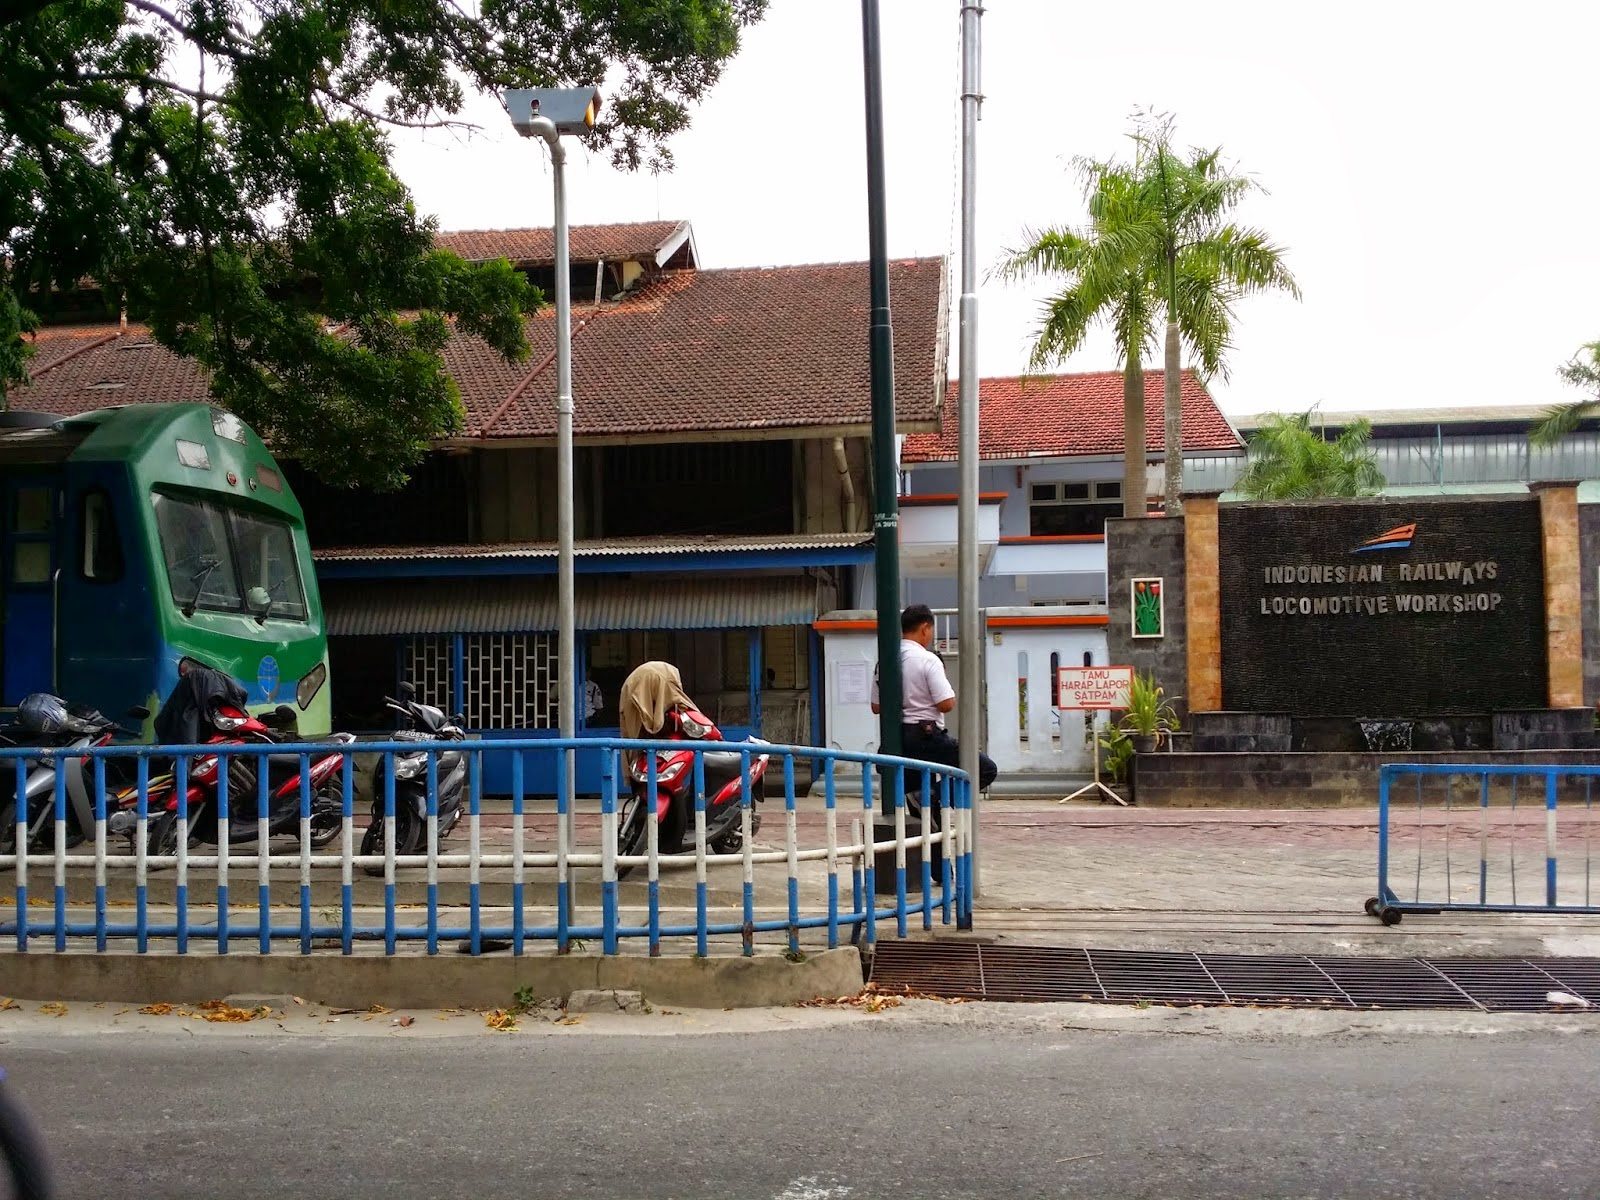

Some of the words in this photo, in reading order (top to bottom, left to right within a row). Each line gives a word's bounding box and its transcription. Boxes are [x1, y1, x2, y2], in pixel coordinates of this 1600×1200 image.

[1264, 565, 1383, 584] INDONESIAN
[1400, 561, 1498, 585] RAILWAYS
[1260, 596, 1388, 615] LOCOMOTIVE
[1395, 593, 1501, 613] WORKSHOP
[1081, 671, 1109, 680] TAMU
[1061, 681, 1093, 690] HARAP
[1096, 680, 1129, 690] LAPOR
[1074, 691, 1117, 700] SATPAM
